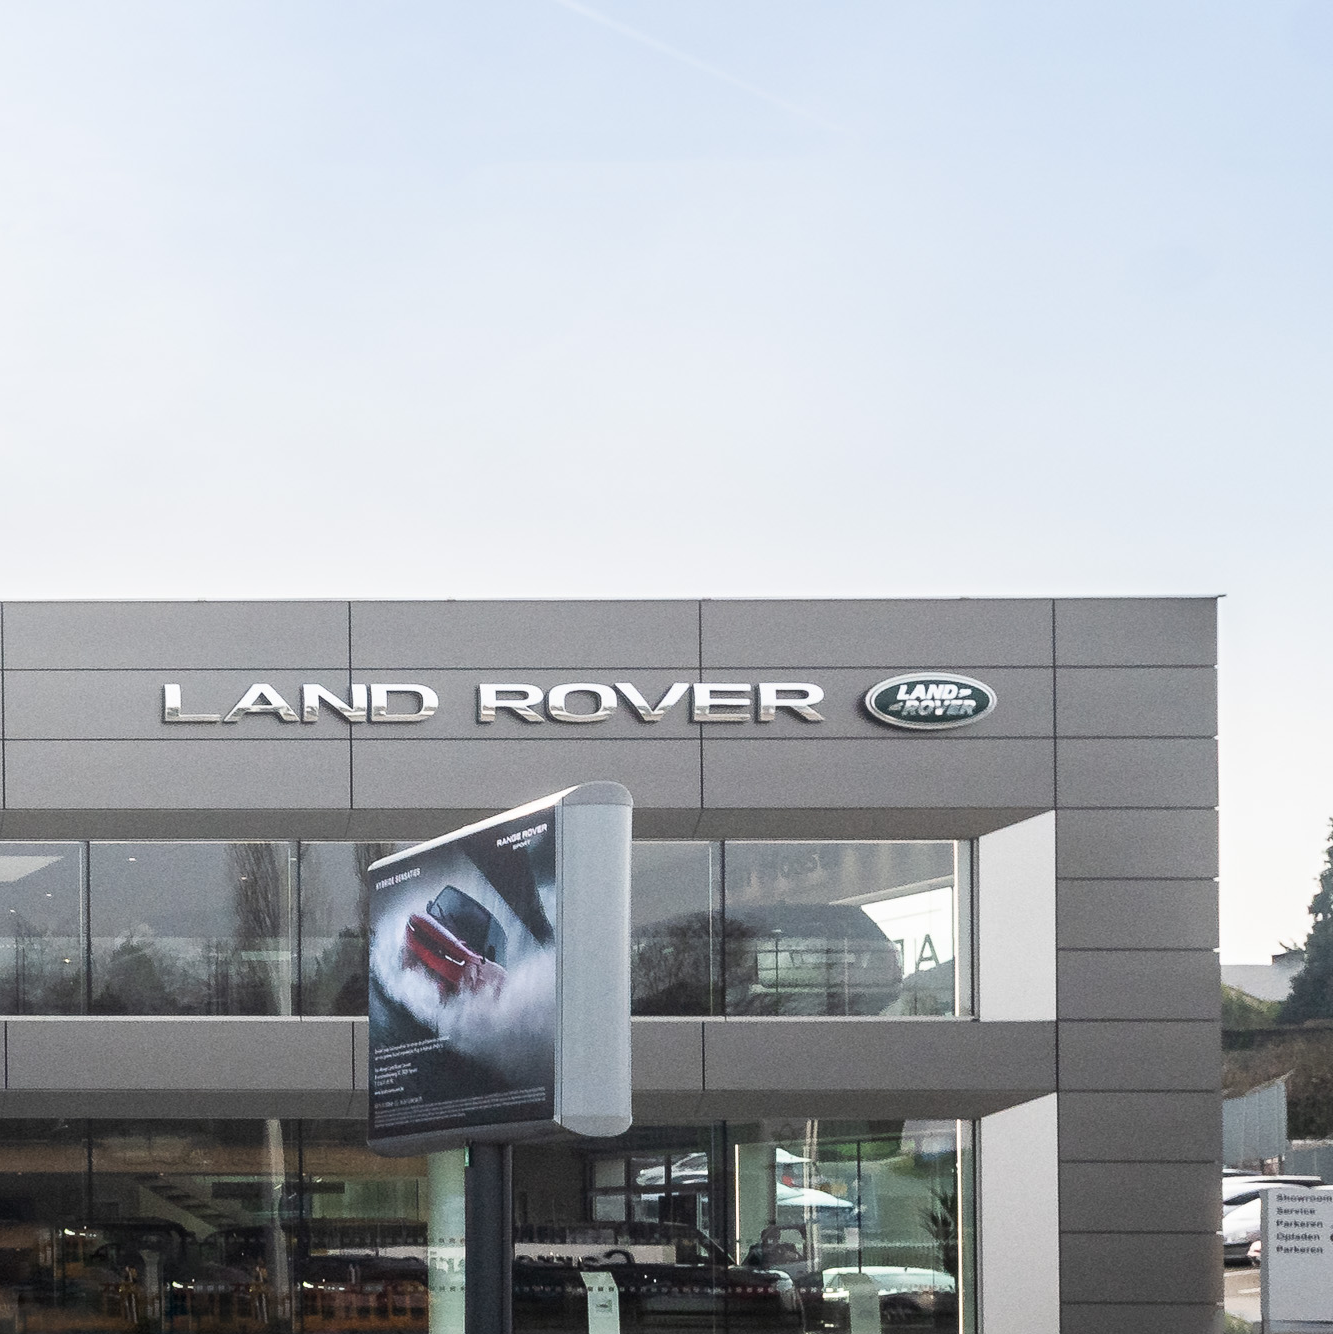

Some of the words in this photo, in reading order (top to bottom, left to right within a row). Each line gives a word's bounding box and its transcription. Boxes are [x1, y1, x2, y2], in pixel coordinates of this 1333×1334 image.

[896, 683, 959, 701] LAND
[161, 682, 440, 725] LAND
[478, 682, 827, 725] ROVER
[901, 699, 977, 716] ROVER
[1276, 1193, 1333, 1203] Showroom
[1276, 1207, 1316, 1216] Service
[1276, 1220, 1323, 1229] Parkeren
